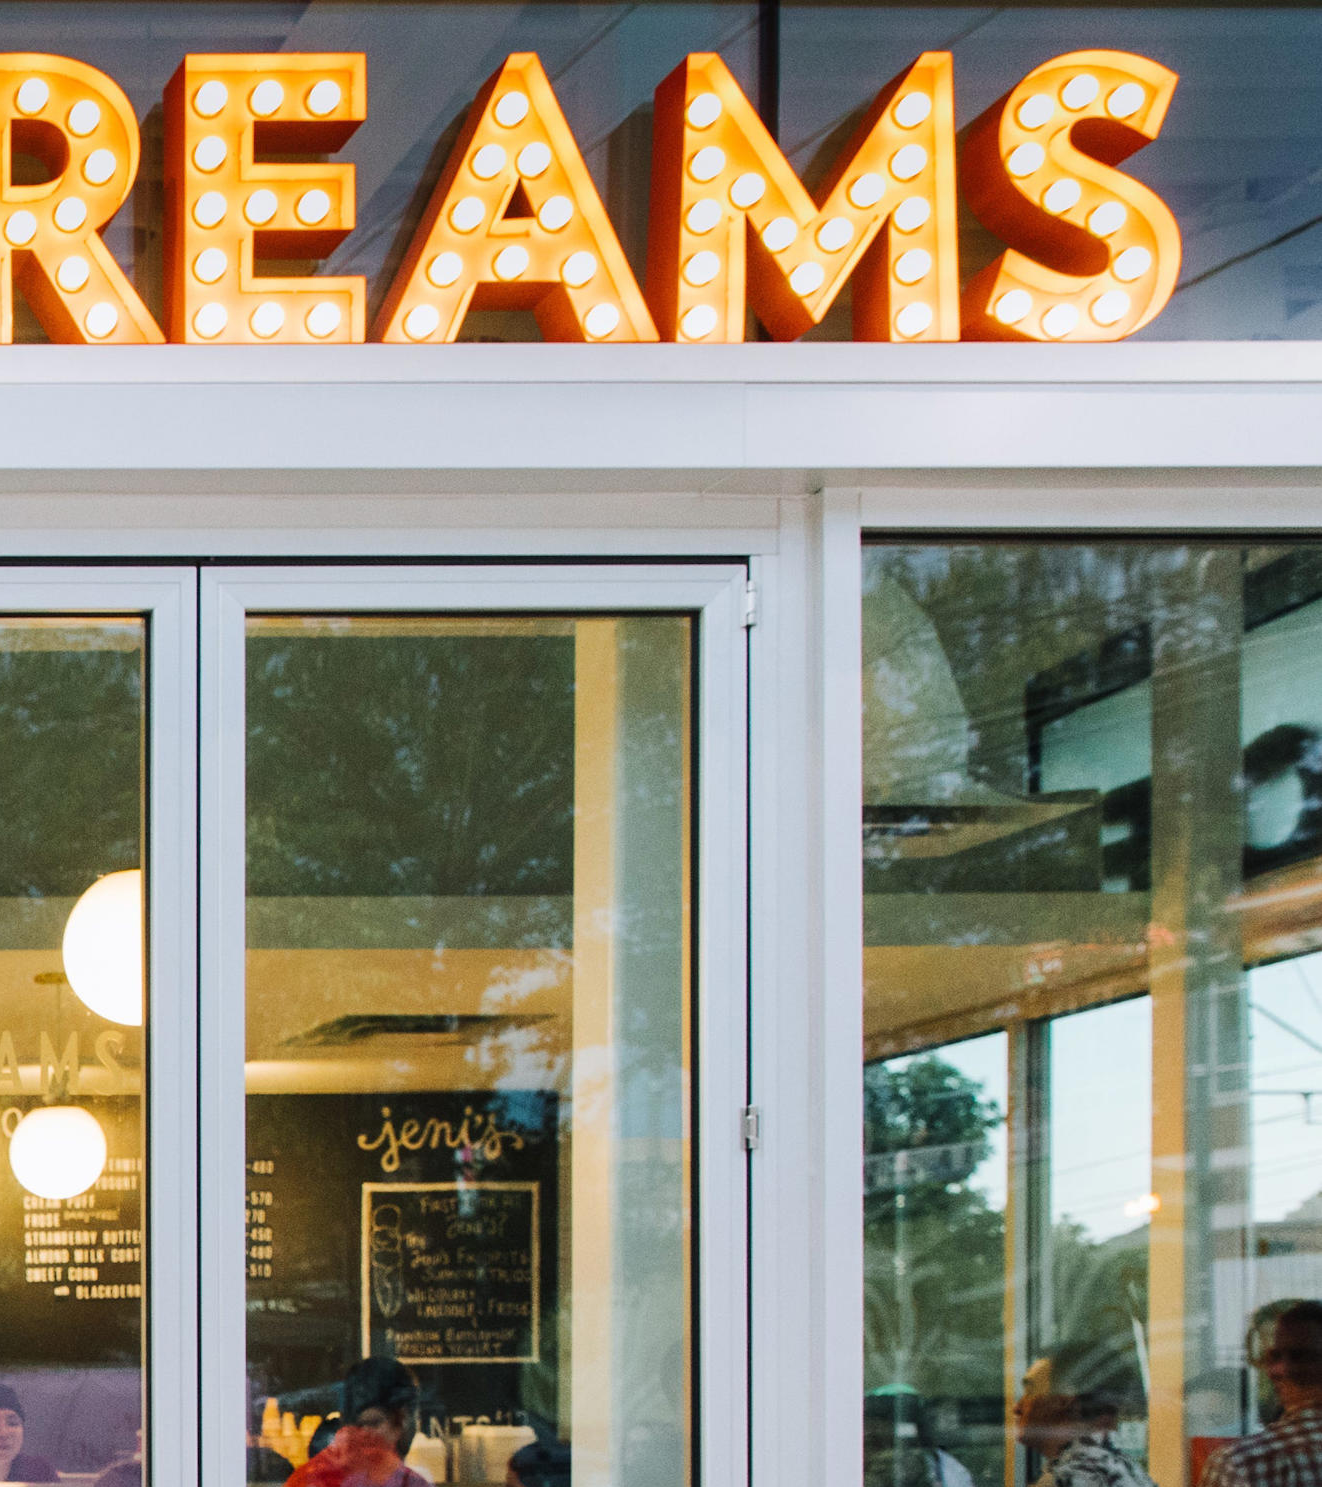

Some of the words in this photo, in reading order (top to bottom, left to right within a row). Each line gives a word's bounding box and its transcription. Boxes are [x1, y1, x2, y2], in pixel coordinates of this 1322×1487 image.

[358, 1105, 524, 1172] jeni's
[102, 1230, 141, 1245] BUTTE
[76, 1284, 141, 1299] BLACKBERR
